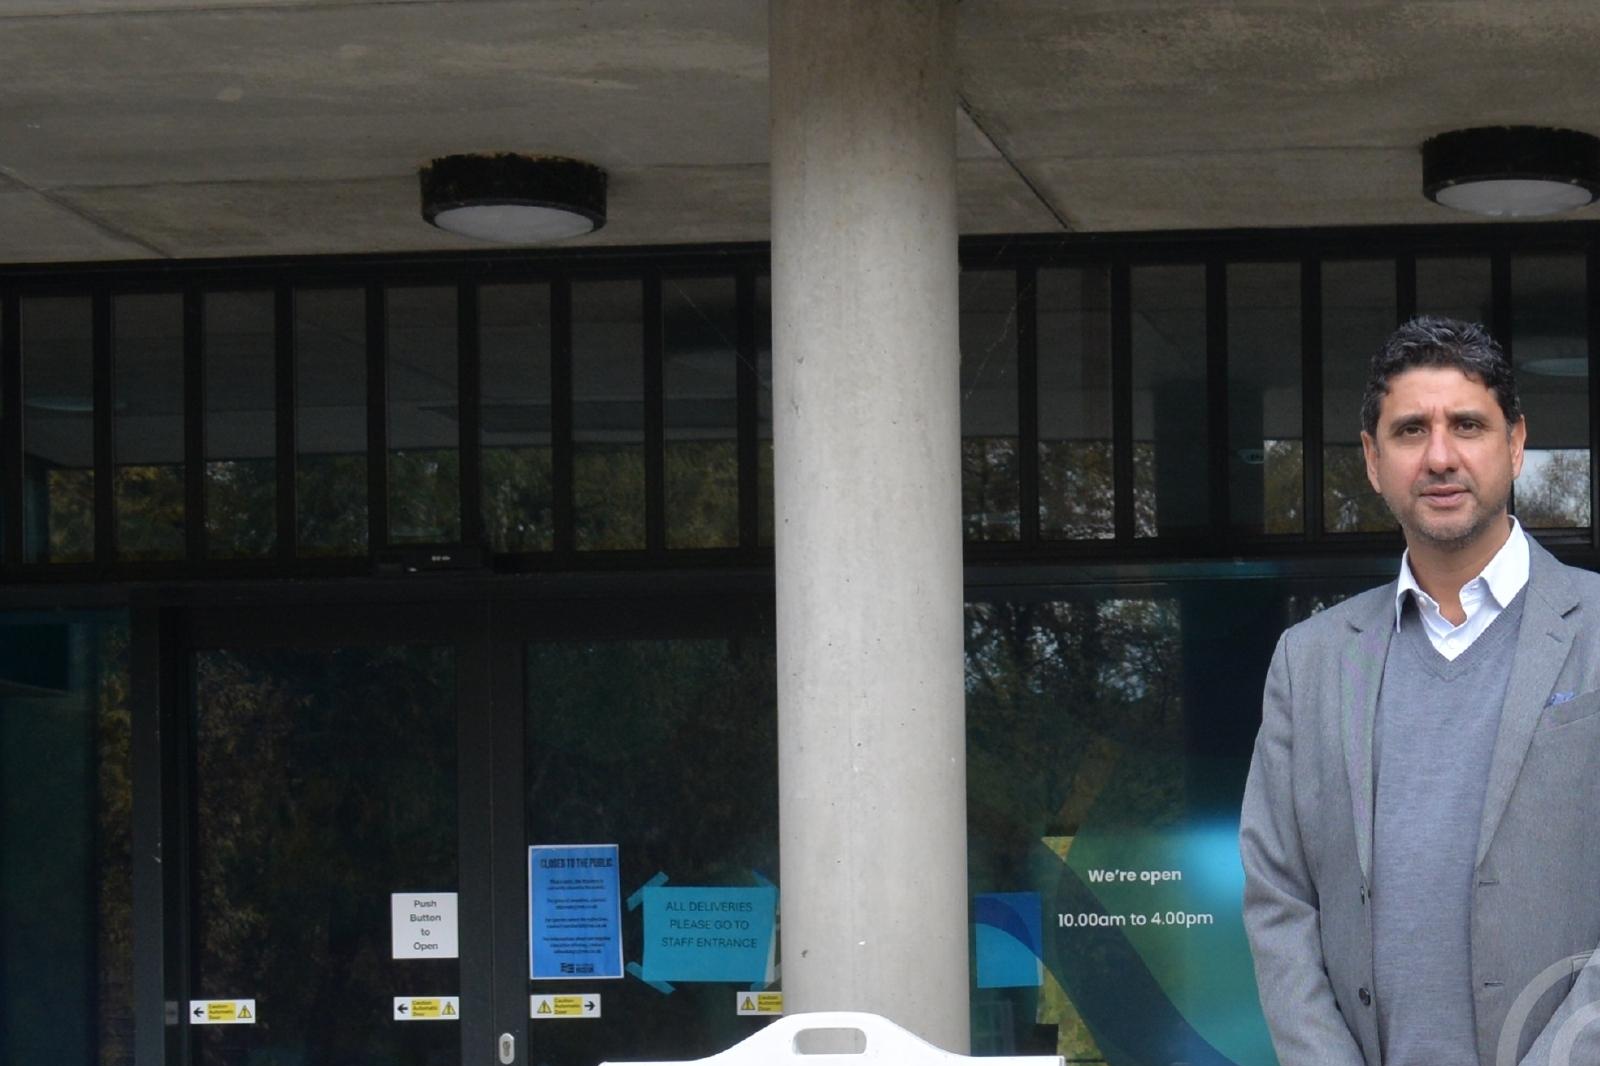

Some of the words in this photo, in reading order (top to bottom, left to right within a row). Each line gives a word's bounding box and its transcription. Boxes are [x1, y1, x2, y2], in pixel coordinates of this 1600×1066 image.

[1140, 870, 1182, 885] open
[665, 901, 686, 912] ALL
[689, 901, 753, 912] DELIVERIES
[410, 914, 442, 922] Button
[1057, 913, 1126, 927] 10.00am
[1130, 912, 1147, 925] to
[1151, 911, 1214, 928] 4.00pm
[670, 919, 711, 930] PLEASE
[714, 920, 732, 930] GO
[735, 920, 749, 930] TO
[420, 928, 431, 936] to
[413, 942, 438, 951] Open
[662, 937, 695, 948] STAFF
[697, 937, 758, 949] ENTRANCE
